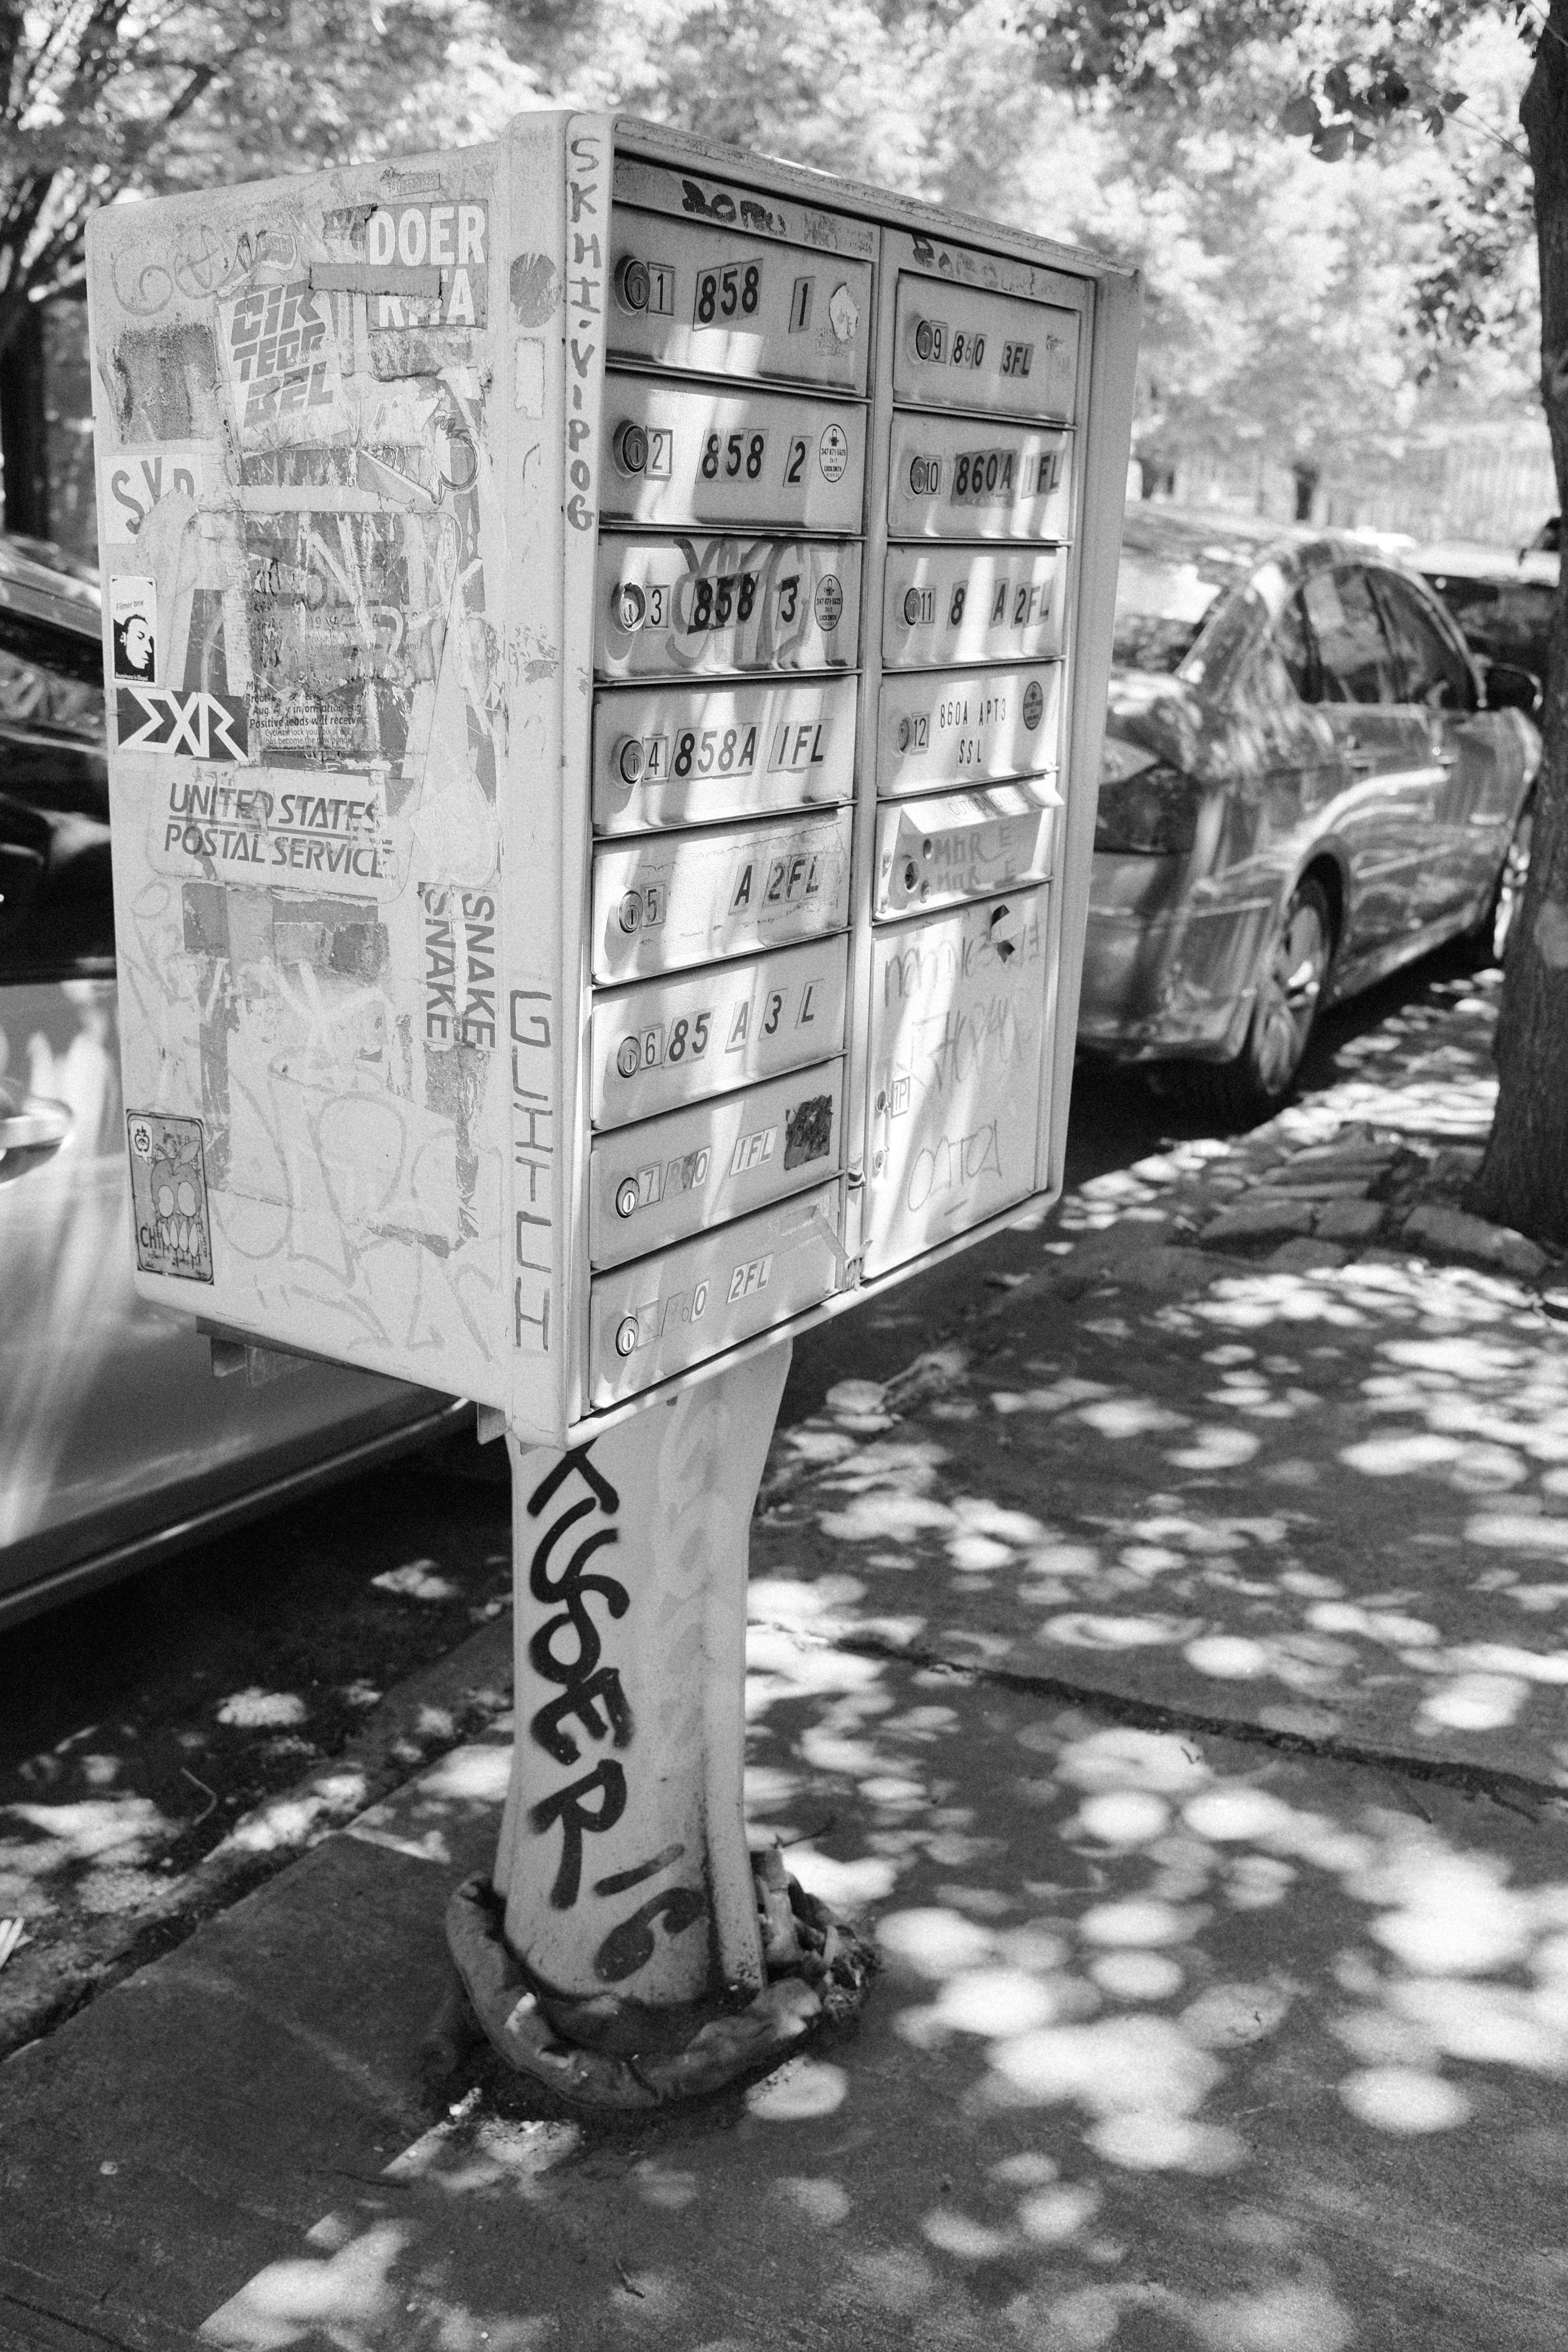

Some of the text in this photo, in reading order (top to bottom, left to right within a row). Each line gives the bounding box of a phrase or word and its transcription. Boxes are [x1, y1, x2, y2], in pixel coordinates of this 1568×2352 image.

[369, 206, 485, 266] DOER
[657, 274, 664, 310] 1
[698, 266, 808, 326] 858 1
[934, 329, 941, 359] 9
[954, 335, 1029, 375] 860 3FL
[652, 433, 663, 470] 2
[702, 434, 806, 483] 858 2
[926, 462, 938, 492] 10
[957, 454, 1059, 495] 860A 1FL
[651, 590, 662, 625] 3
[694, 574, 798, 629] 858 3
[922, 591, 932, 621] 11
[951, 588, 965, 625] 8
[914, 717, 926, 747] 12
[940, 701, 968, 728] 860A
[649, 742, 659, 775] 4
[675, 724, 824, 777] 858A 1FL
[959, 739, 982, 764] SSL
[170, 782, 380, 833] UNITED STATES
[165, 824, 265, 863] POSTAL
[272, 836, 395, 879] SERVICE
[734, 856, 819, 906] A 2FL
[647, 889, 657, 922] 5
[669, 986, 815, 1062] 85 A 3 L
[645, 1032, 656, 1065] 6
[730, 1258, 767, 1300] 2FL
